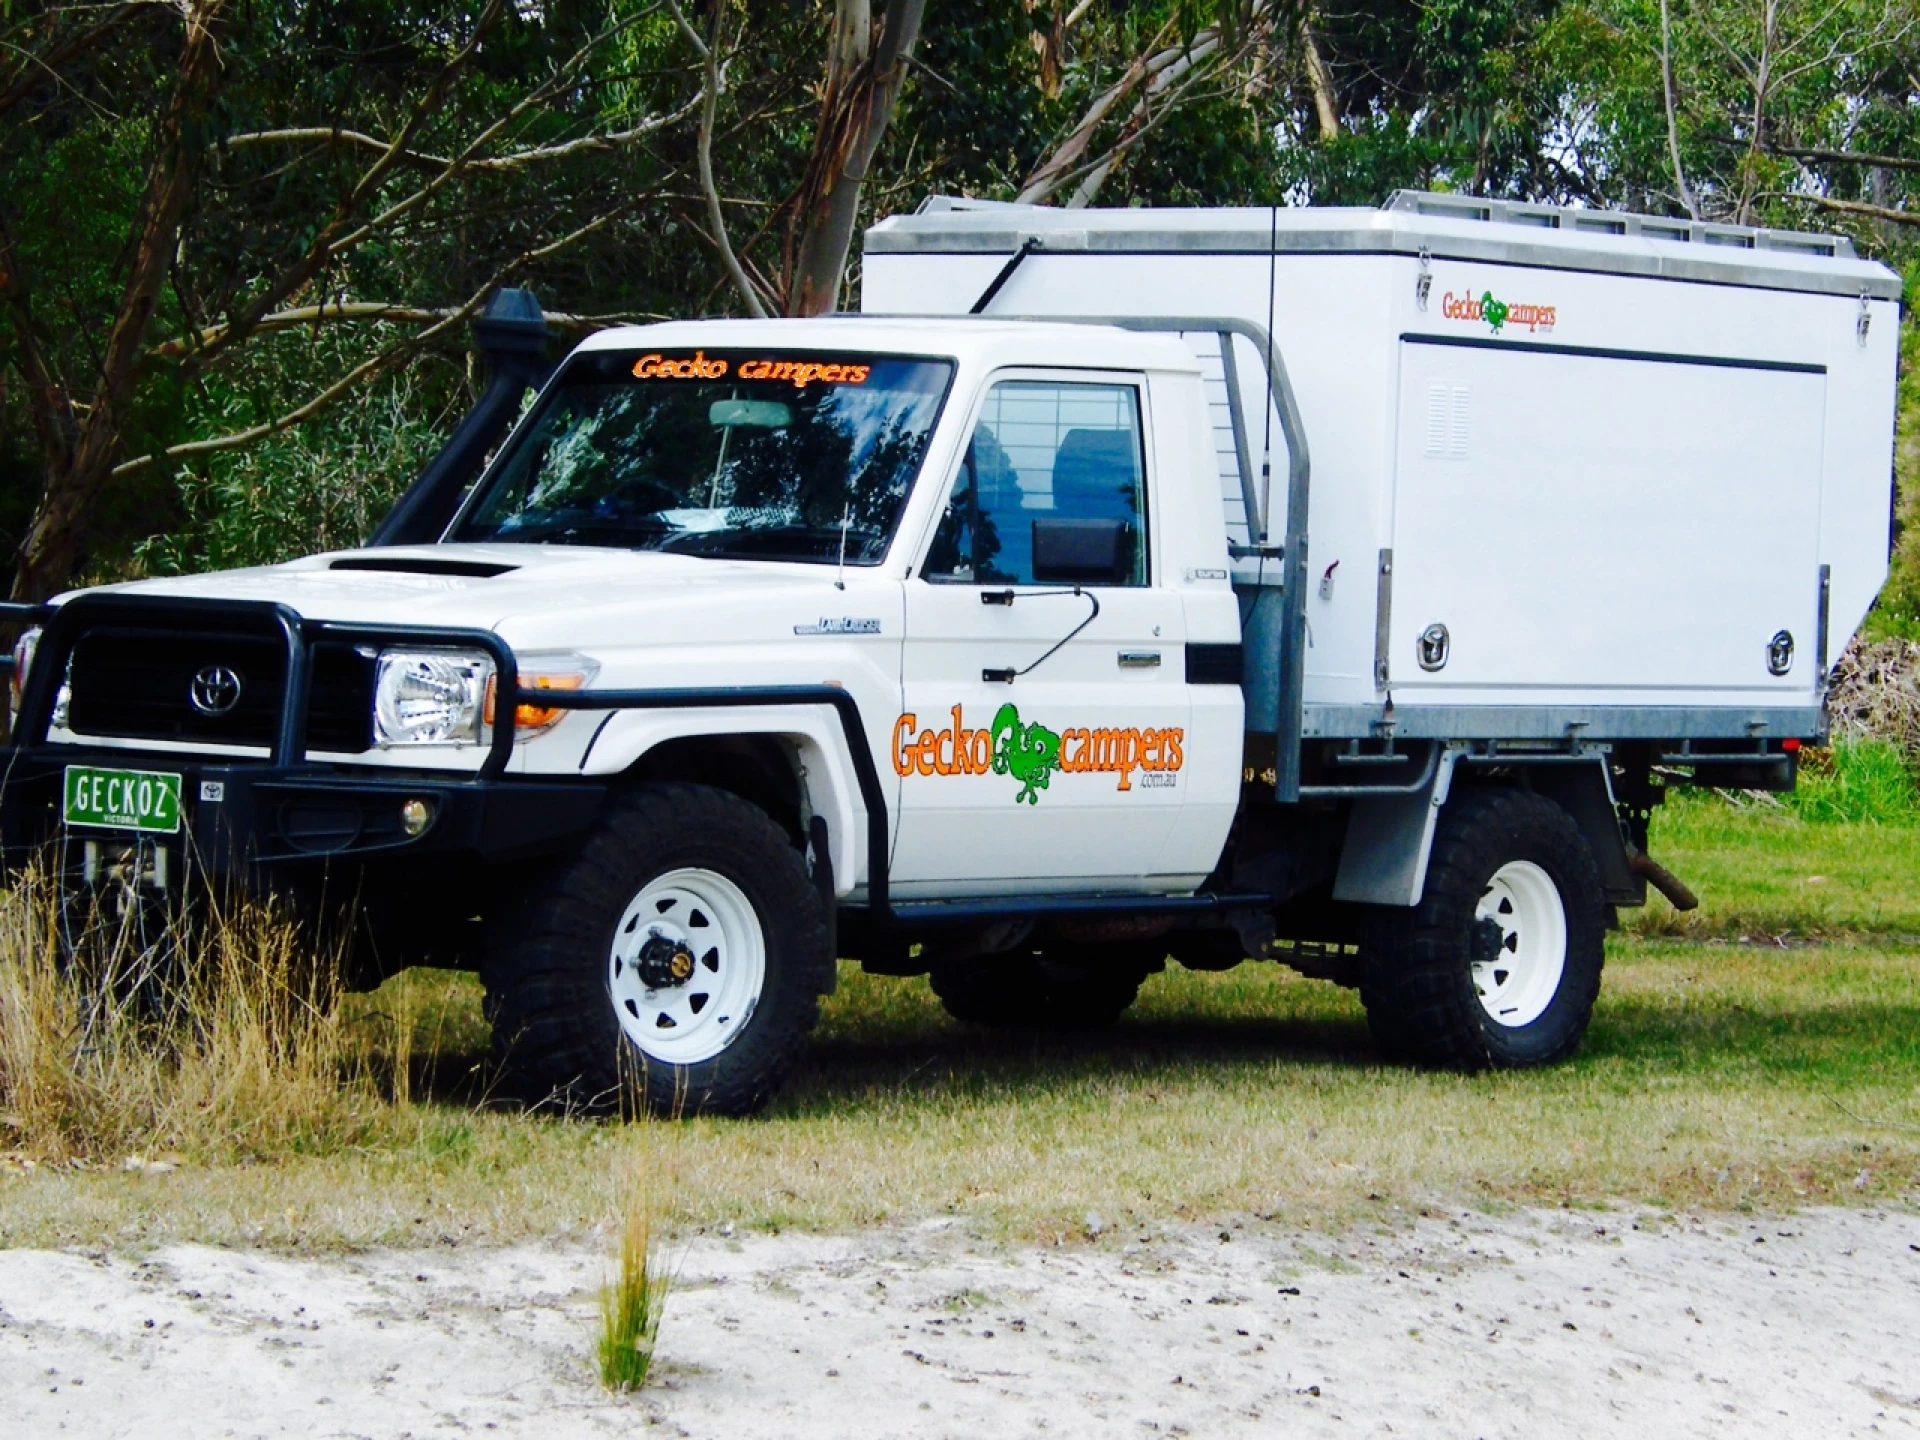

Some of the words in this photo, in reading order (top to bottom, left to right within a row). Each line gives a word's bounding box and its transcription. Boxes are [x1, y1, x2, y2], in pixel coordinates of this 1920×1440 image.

[1443, 288, 1482, 320] Gecko
[1507, 303, 1556, 332] campers
[632, 350, 729, 378] Gecko
[737, 359, 871, 387] campers
[891, 703, 992, 776] Gecko
[1060, 727, 1184, 791] campers
[77, 776, 168, 818] GECKOZ
[1140, 773, 1177, 788] .com.au
